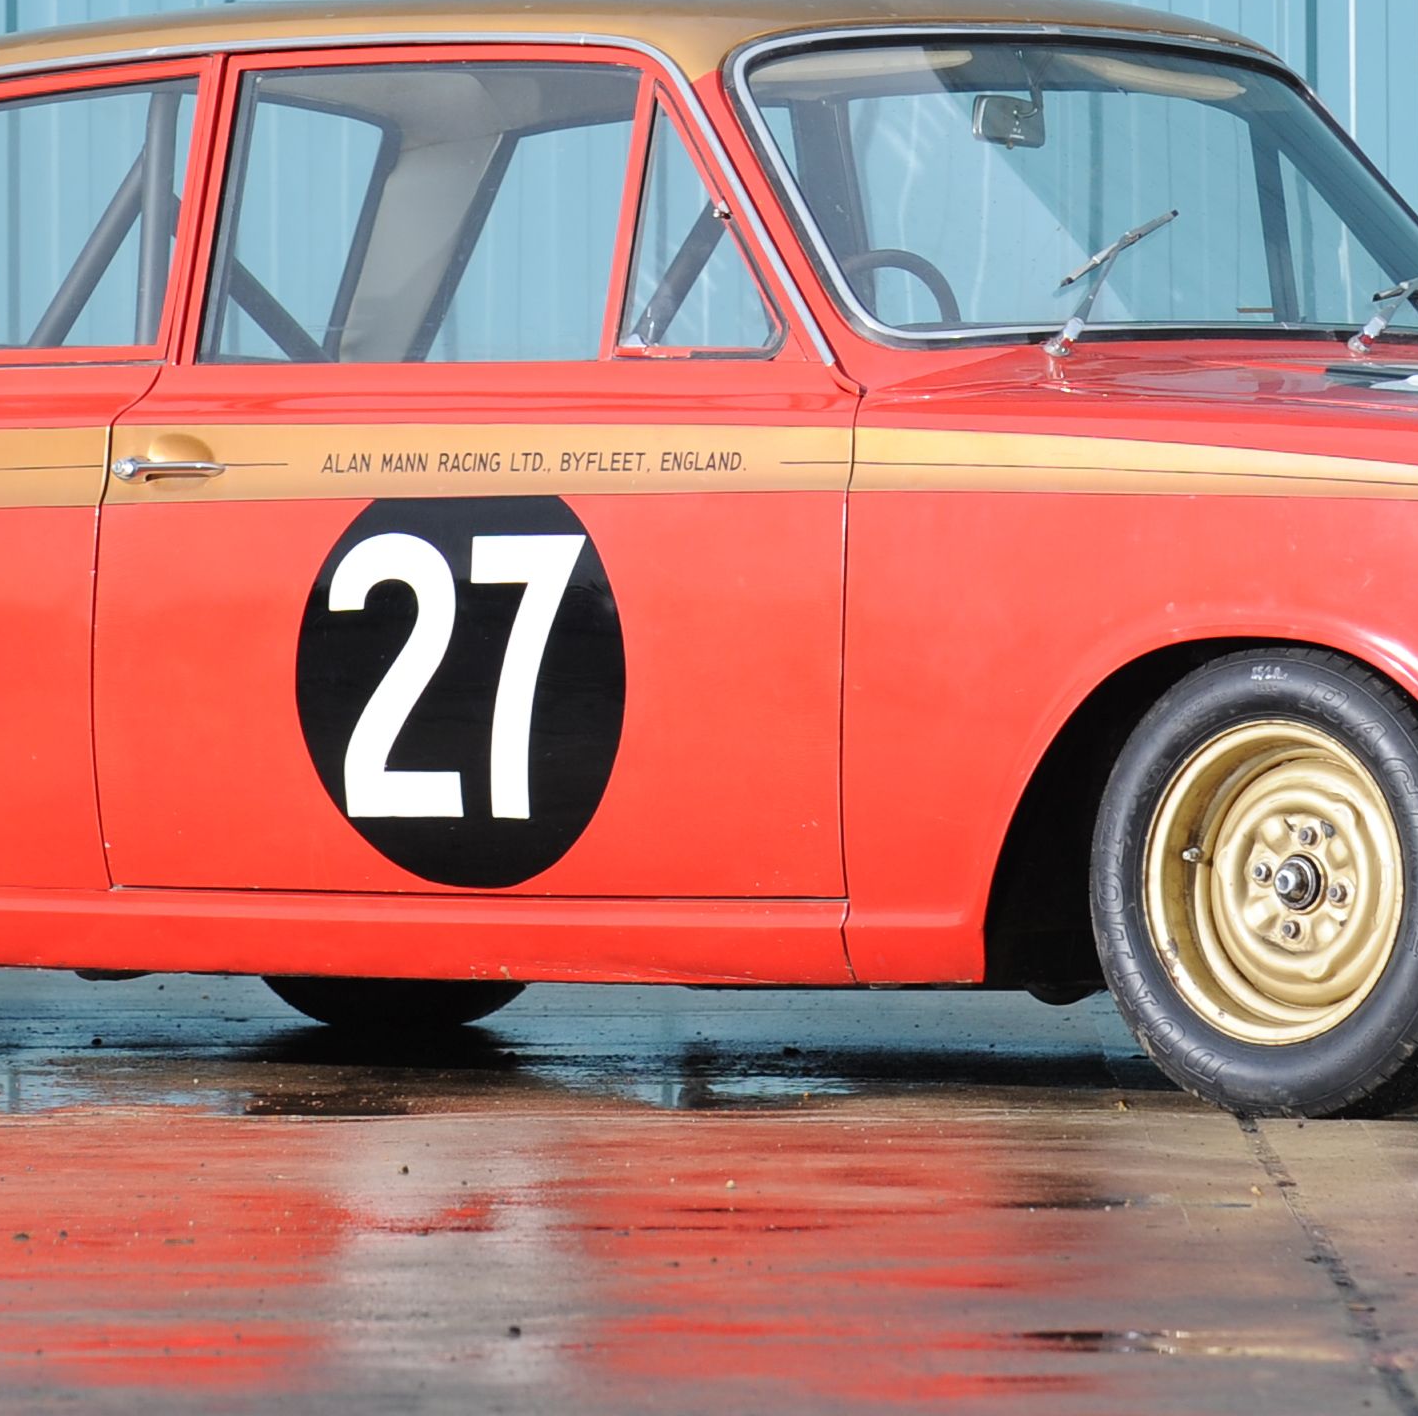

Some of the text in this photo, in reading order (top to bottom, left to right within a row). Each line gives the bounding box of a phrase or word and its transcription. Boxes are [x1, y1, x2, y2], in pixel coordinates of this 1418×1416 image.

[321, 452, 372, 473] ALAN
[380, 452, 429, 473] MANN
[437, 451, 501, 473] RACING
[559, 451, 651, 473] BYFLEET,
[659, 450, 747, 472] ENGLAND.
[328, 532, 587, 820] 27
[1096, 804, 1234, 1084] DUNLOP
